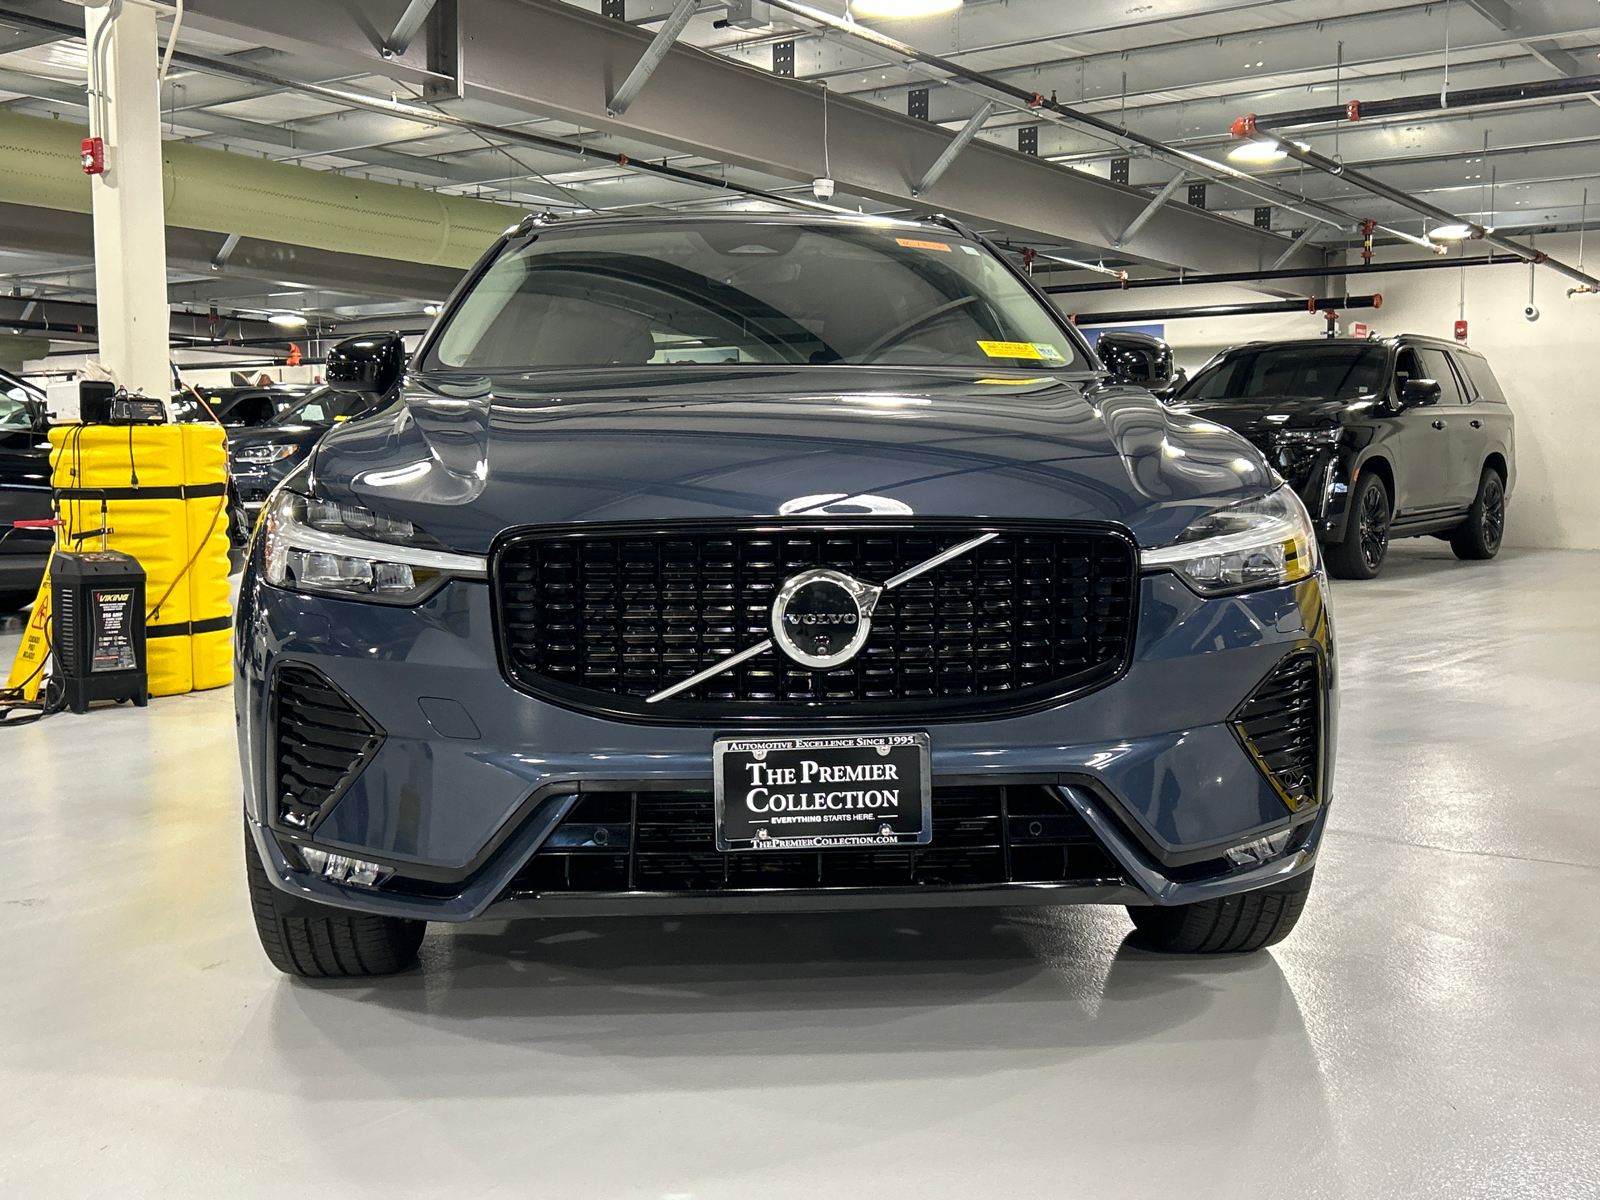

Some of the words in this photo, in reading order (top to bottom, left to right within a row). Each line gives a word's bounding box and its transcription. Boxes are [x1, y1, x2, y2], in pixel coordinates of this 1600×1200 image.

[99, 593, 130, 602] VIKING
[786, 613, 857, 625] VOLVO
[730, 742, 792, 751] AUTOMOTIVE
[795, 739, 854, 748] EXCELLENCE
[856, 737, 885, 746] SINCE
[888, 736, 914, 745] 1995
[745, 761, 796, 786] THE
[799, 760, 899, 784] PREMIER
[746, 787, 899, 813] COLLECTION
[771, 815, 822, 824] EVERYTHING
[823, 814, 851, 822] STARTS
[852, 813, 875, 821] HERE.
